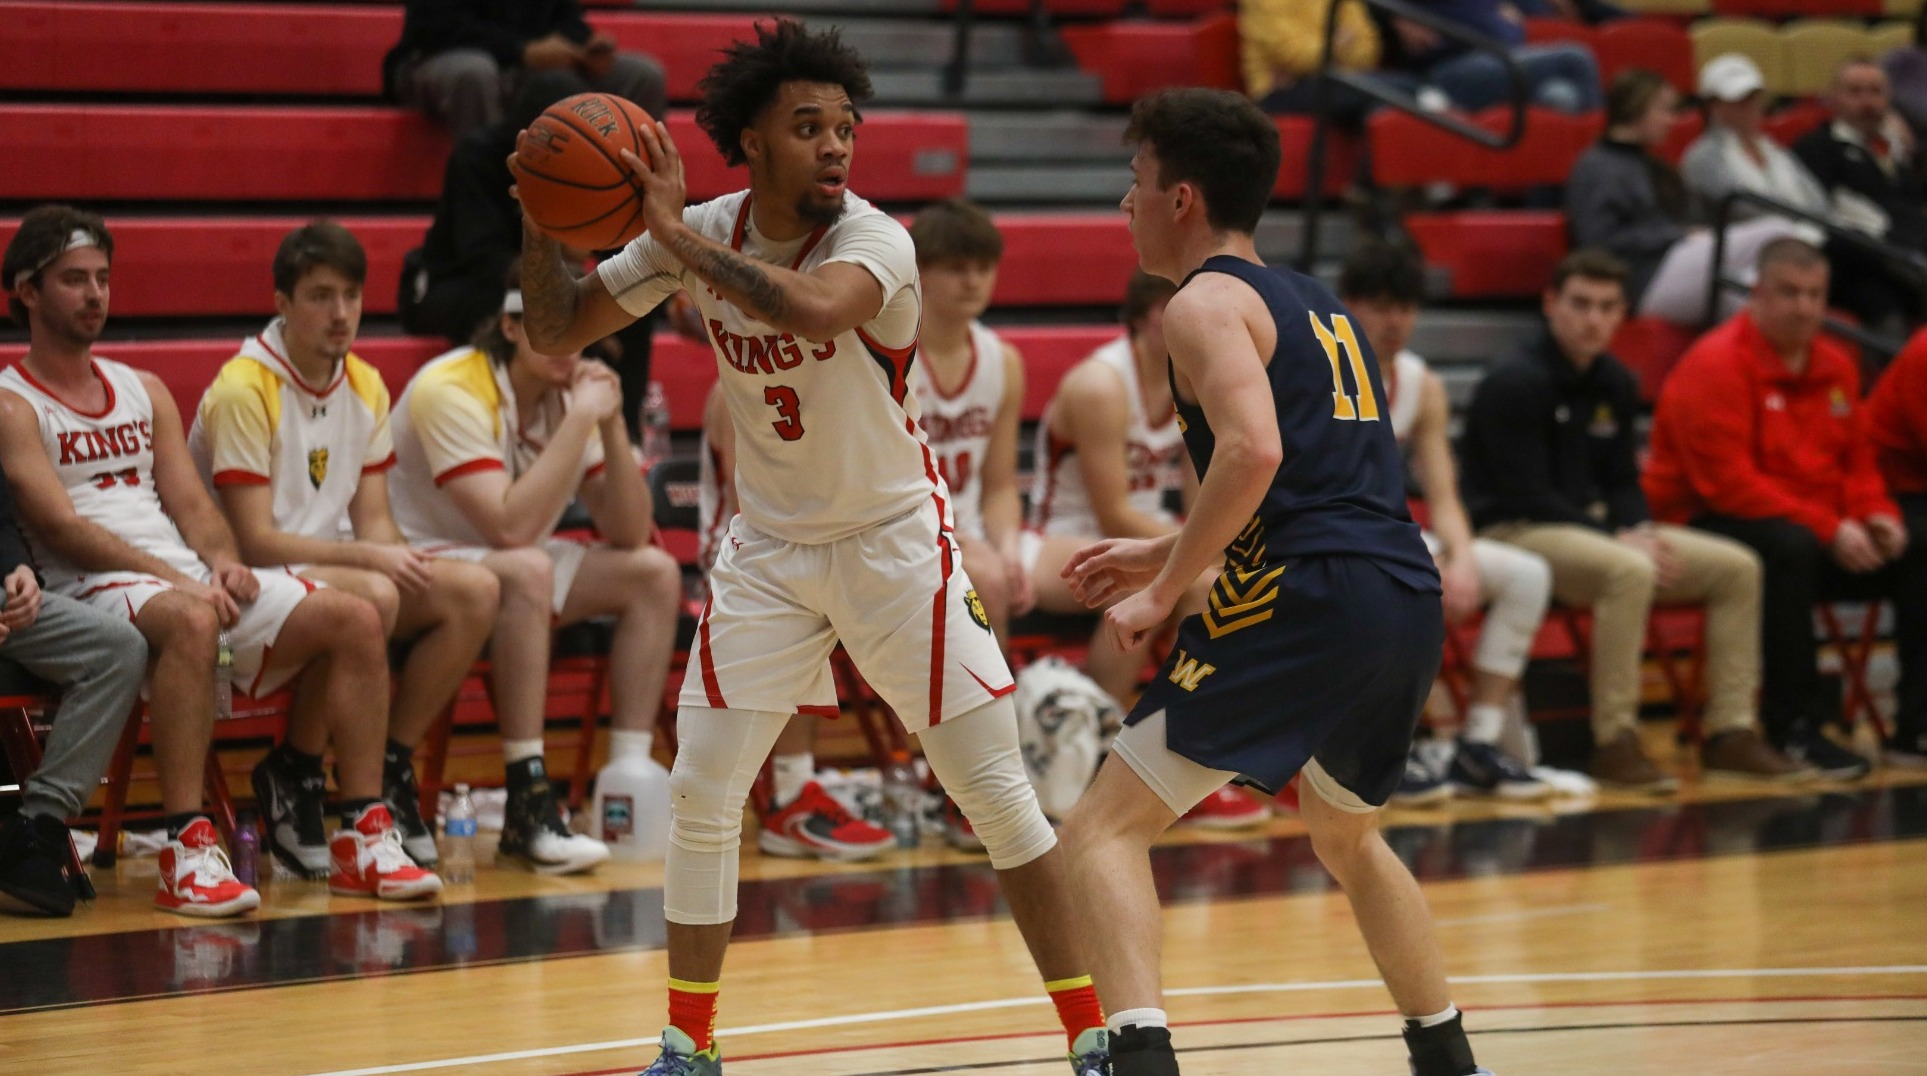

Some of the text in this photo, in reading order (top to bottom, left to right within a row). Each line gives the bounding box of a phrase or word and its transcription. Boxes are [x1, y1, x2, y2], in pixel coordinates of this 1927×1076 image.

[709, 318, 836, 375] KINGS
[1308, 310, 1380, 422] 11
[763, 384, 805, 442] 3
[57, 420, 153, 466] KING'S
[1168, 649, 1216, 692] W
